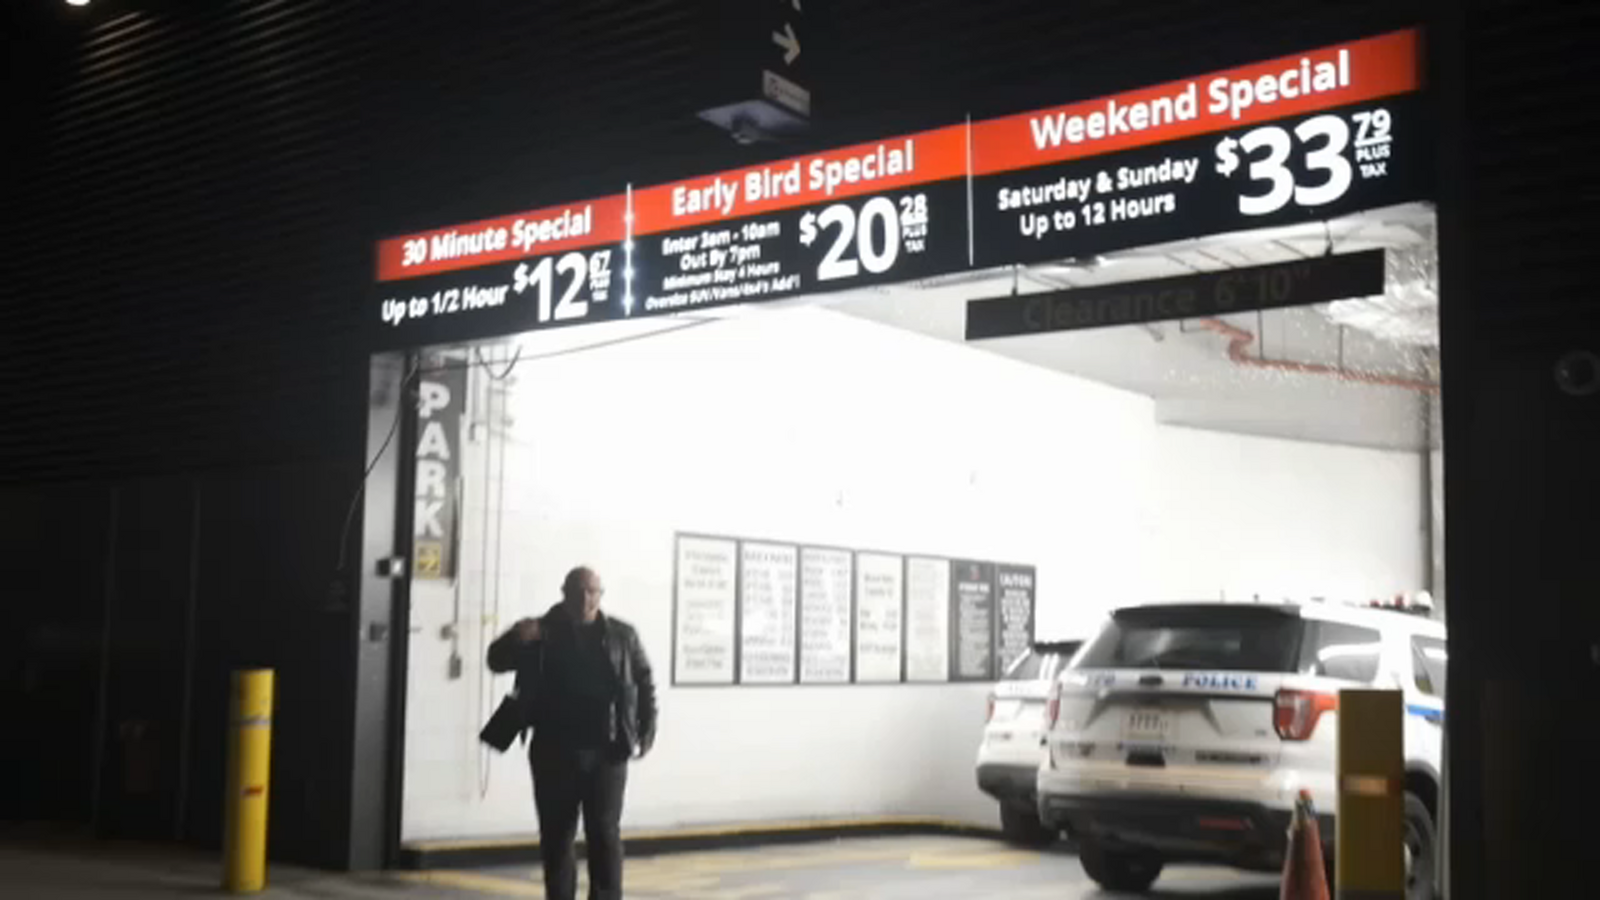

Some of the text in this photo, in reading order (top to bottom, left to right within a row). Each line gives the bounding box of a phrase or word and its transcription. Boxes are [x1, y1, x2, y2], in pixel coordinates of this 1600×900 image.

[1030, 49, 1351, 151] Weekend Special
[1215, 108, 1392, 216] $33 79
[1356, 142, 1391, 162] PLUS
[1360, 162, 1388, 178] TAX
[671, 138, 915, 216] Early Bird Special
[998, 157, 1199, 212] Saturday & Sunday
[401, 204, 593, 267] 30 Minute Special
[661, 232, 699, 256] Enter
[741, 220, 781, 242] 10am
[799, 193, 929, 282] $20 28
[1020, 191, 1176, 239] Up to 12 Hours
[679, 244, 760, 272] Out By 7pm
[747, 260, 781, 277] Hours
[381, 283, 510, 326] Up to 1/2 Hour
[513, 251, 589, 323] $12
[1023, 288, 1196, 330] Clearance
[415, 381, 450, 537] PARK
[1182, 671, 1259, 692] POLICE
